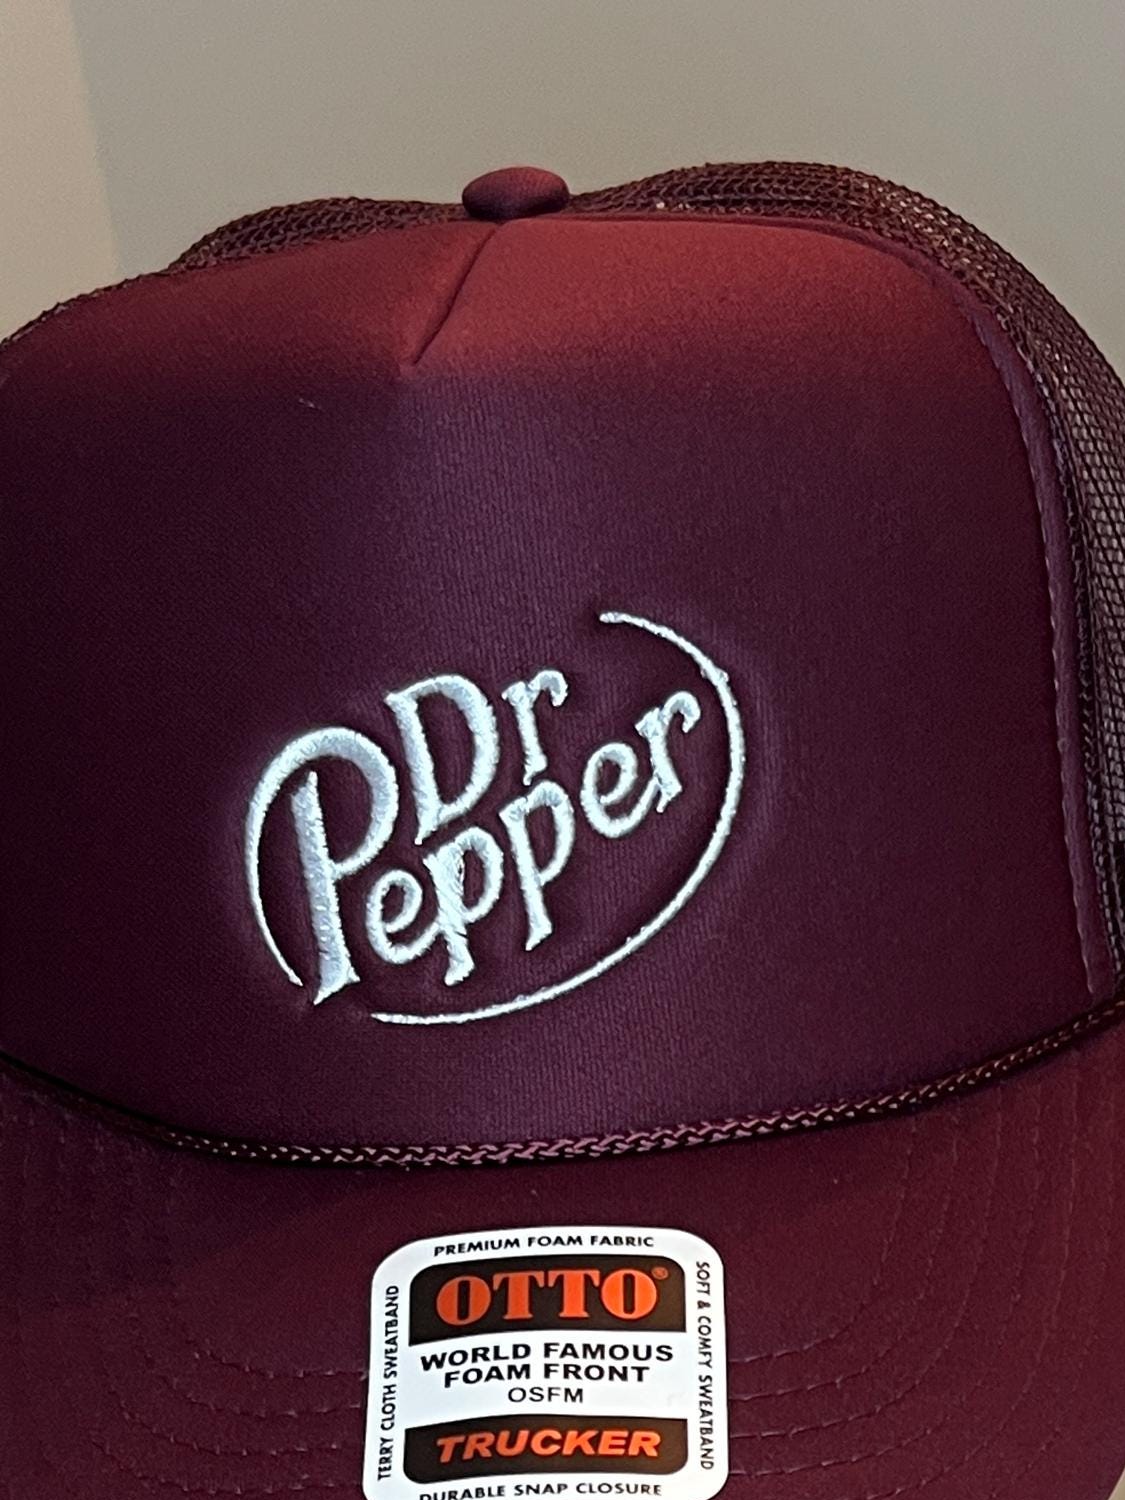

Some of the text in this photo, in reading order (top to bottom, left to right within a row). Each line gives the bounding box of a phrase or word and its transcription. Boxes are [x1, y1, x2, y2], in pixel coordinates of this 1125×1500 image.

[384, 669, 569, 846] Dr
[245, 690, 702, 1006] Pepper
[433, 1234, 655, 1257] PREMIUM FOAM FABRIC
[420, 1342, 674, 1372] WORLD FAMOUS
[695, 1261, 715, 1471] SOFT & COMFY SWEATBAND
[377, 1284, 400, 1481] TERRY CLOTH SWEATBAND
[444, 1363, 651, 1389] FOAM FRONT
[507, 1386, 584, 1403] OSFM
[435, 1429, 662, 1464] TRUCKER
[513, 1482, 569, 1497] SNAP
[576, 1482, 663, 1498] CLOSURE
